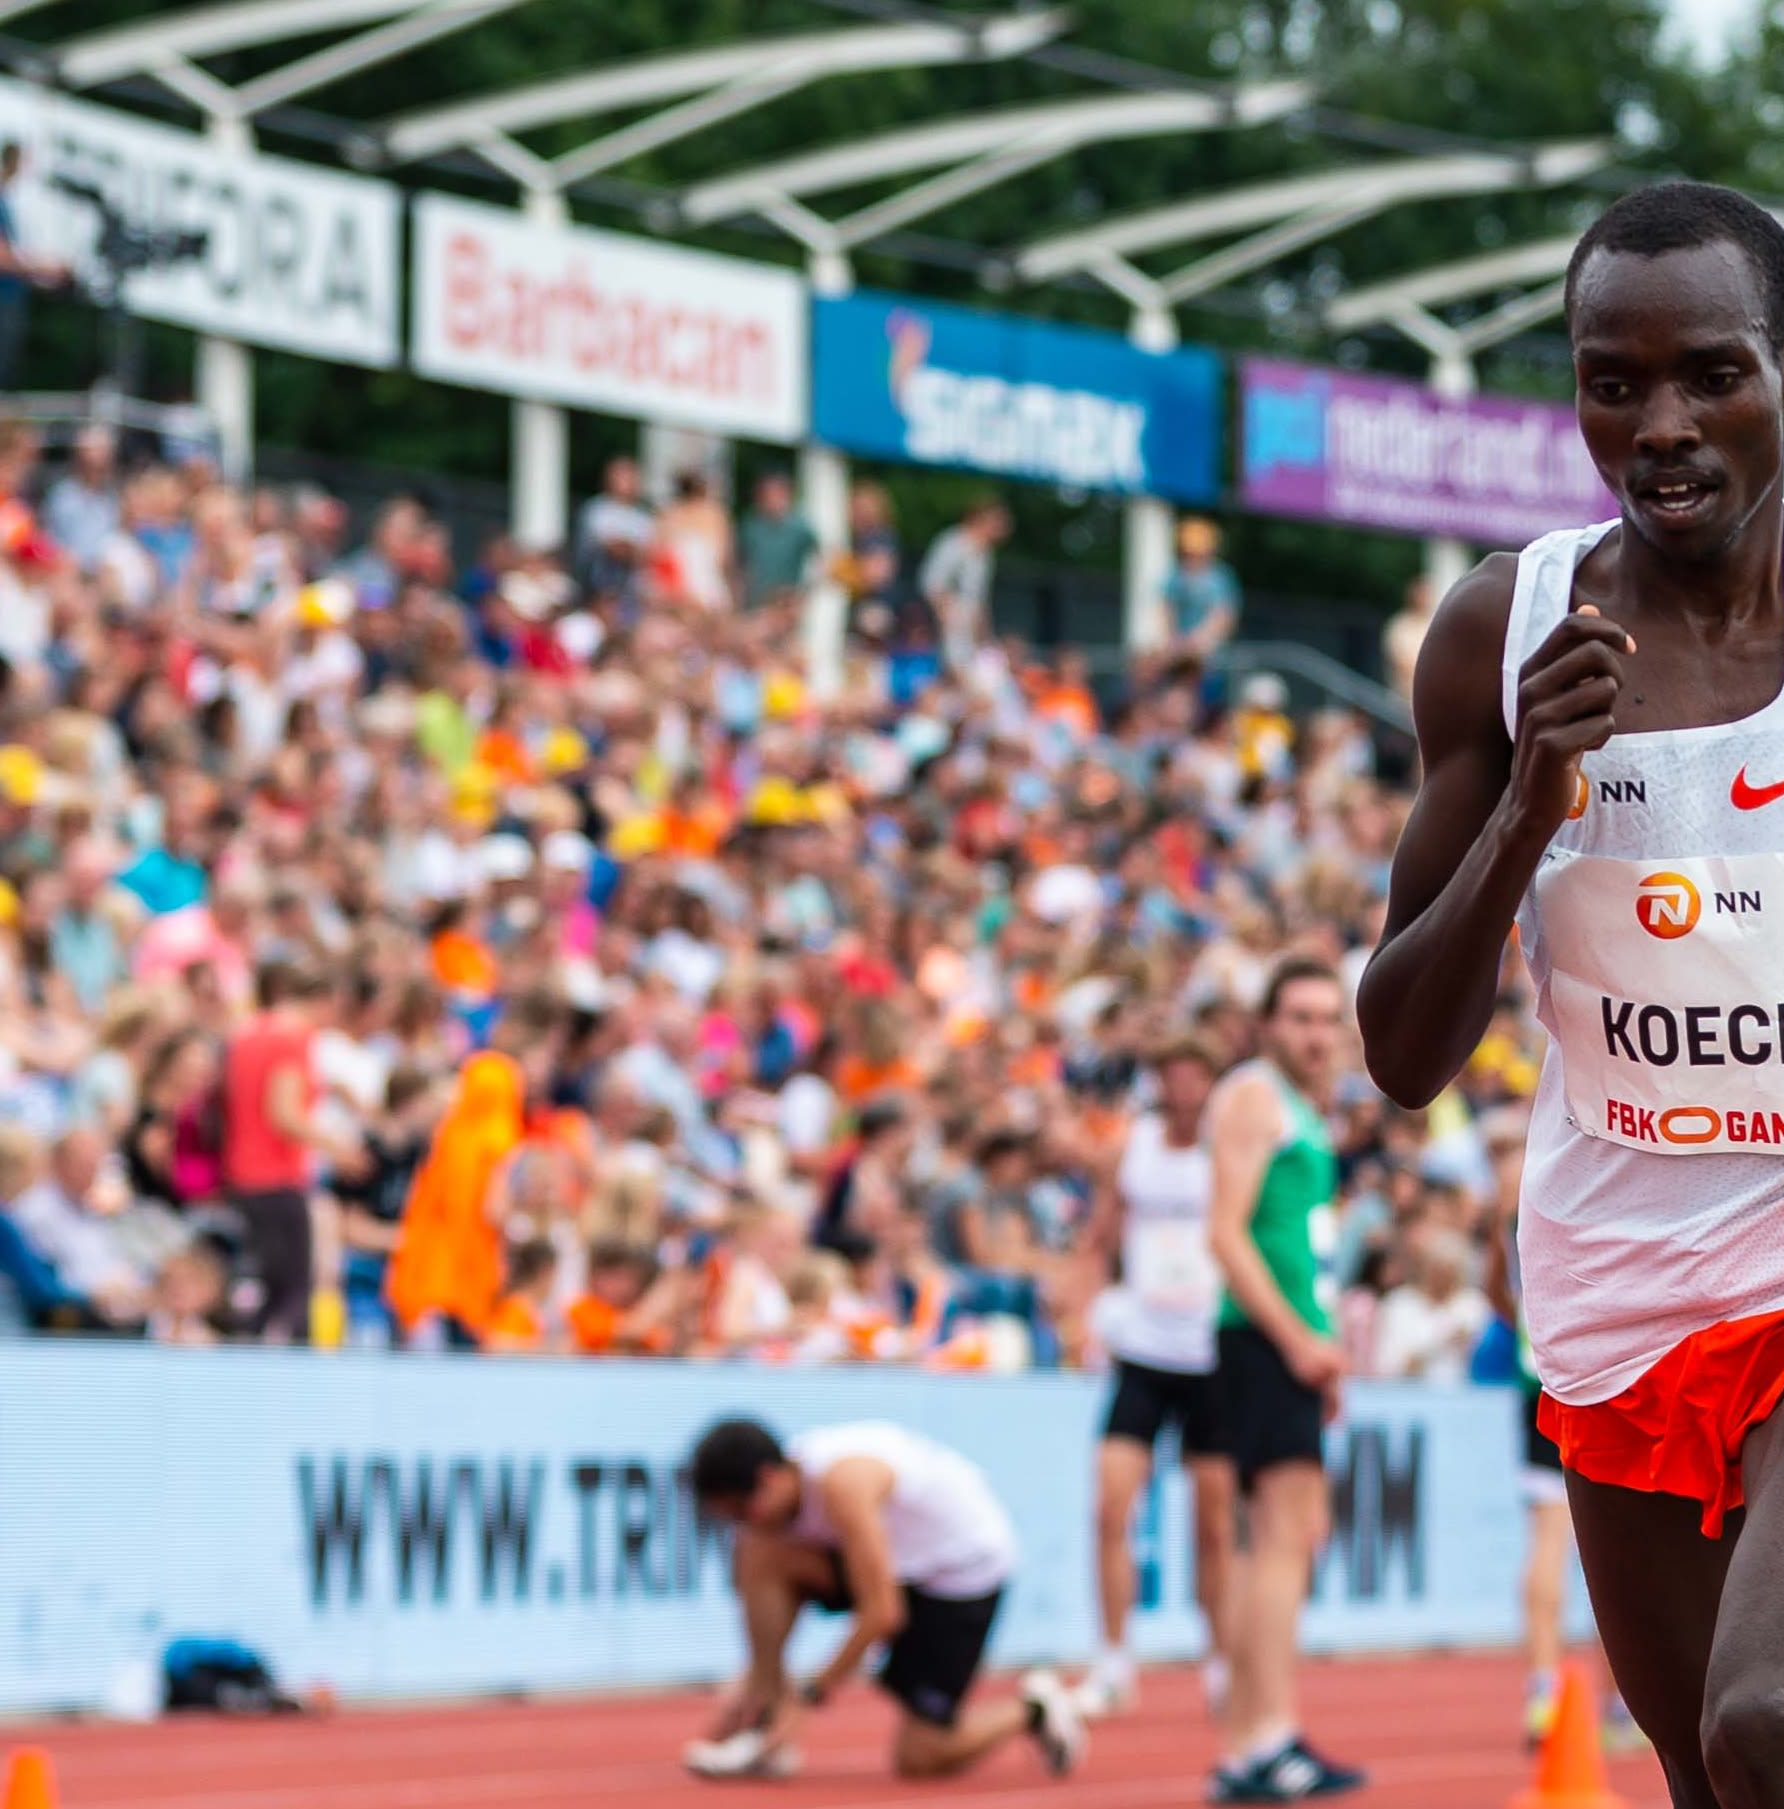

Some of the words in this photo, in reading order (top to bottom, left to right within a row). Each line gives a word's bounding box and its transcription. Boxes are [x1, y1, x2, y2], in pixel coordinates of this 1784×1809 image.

[445, 232, 777, 405] Barbacan
[1599, 780, 1646, 803] NN
[1714, 890, 1761, 913] NN
